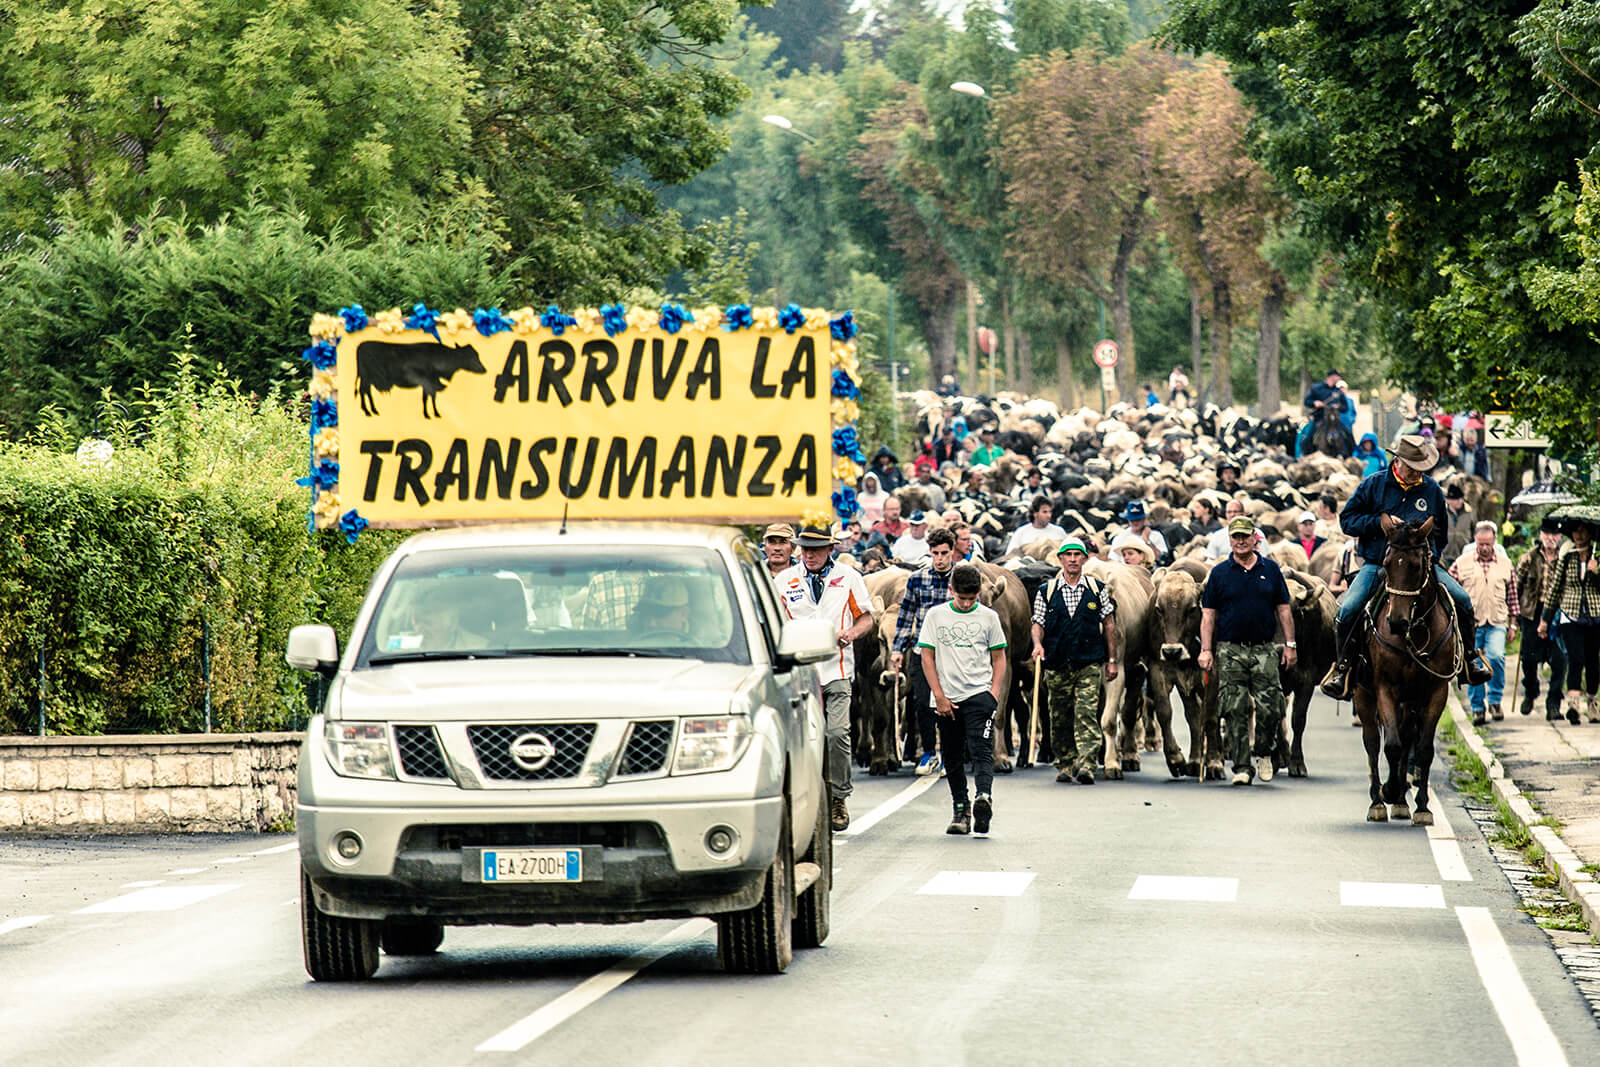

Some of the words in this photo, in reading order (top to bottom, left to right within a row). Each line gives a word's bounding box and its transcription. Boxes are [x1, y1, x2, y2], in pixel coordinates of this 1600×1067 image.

[493, 337, 722, 407] ARRIVA
[750, 335, 816, 399] LA
[358, 434, 817, 506] TRANSUMANZA
